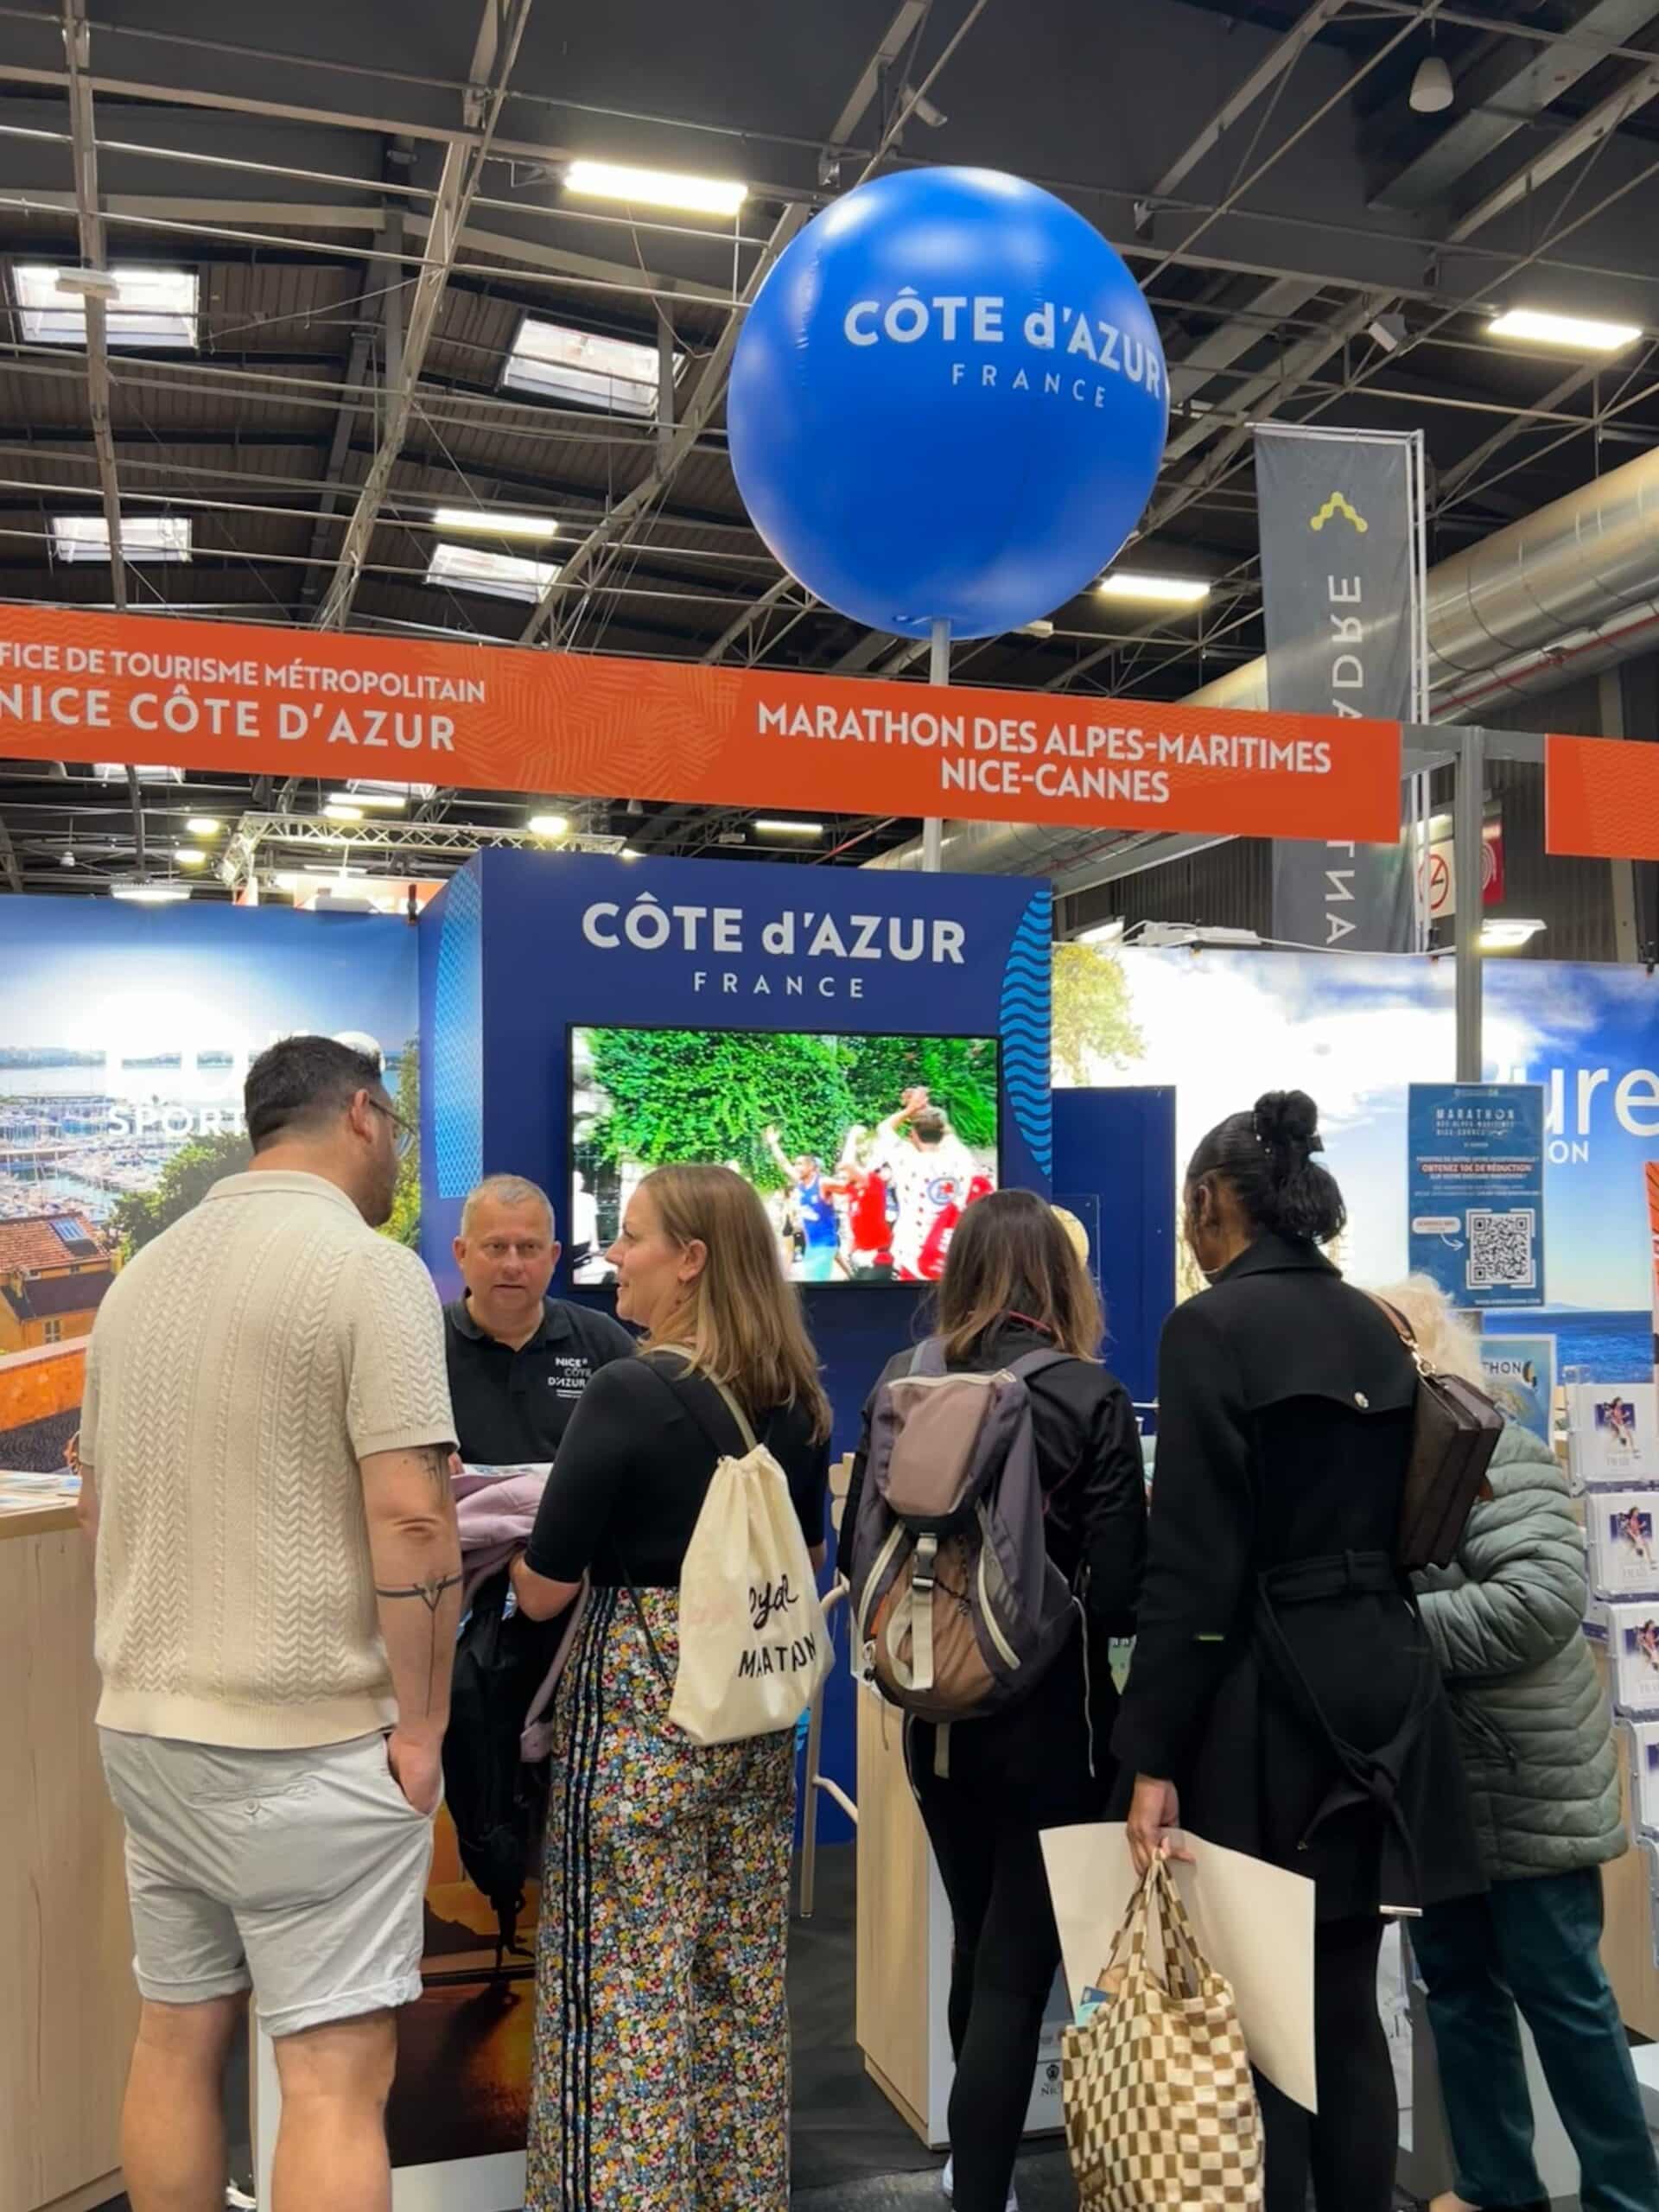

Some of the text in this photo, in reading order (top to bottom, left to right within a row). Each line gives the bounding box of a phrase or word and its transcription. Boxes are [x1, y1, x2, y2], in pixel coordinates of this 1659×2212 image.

[844, 286, 1160, 400] CÔTE d'AZUR
[952, 364, 1106, 409] FRANCE
[67, 647, 105, 674] DE
[110, 651, 258, 686] TOURISME
[264, 658, 486, 702] MÉTROPOLITAIN
[0, 683, 455, 752] NICE CÔTE D'AZUR
[758, 701, 1332, 774] MARATHON DES ALPES-MARITIMES
[940, 758, 1170, 804] NICE-CANNES
[582, 891, 966, 964] CÔTE d'AZUR
[693, 971, 865, 999] FRANCE
[555, 1357, 581, 1367] NICE
